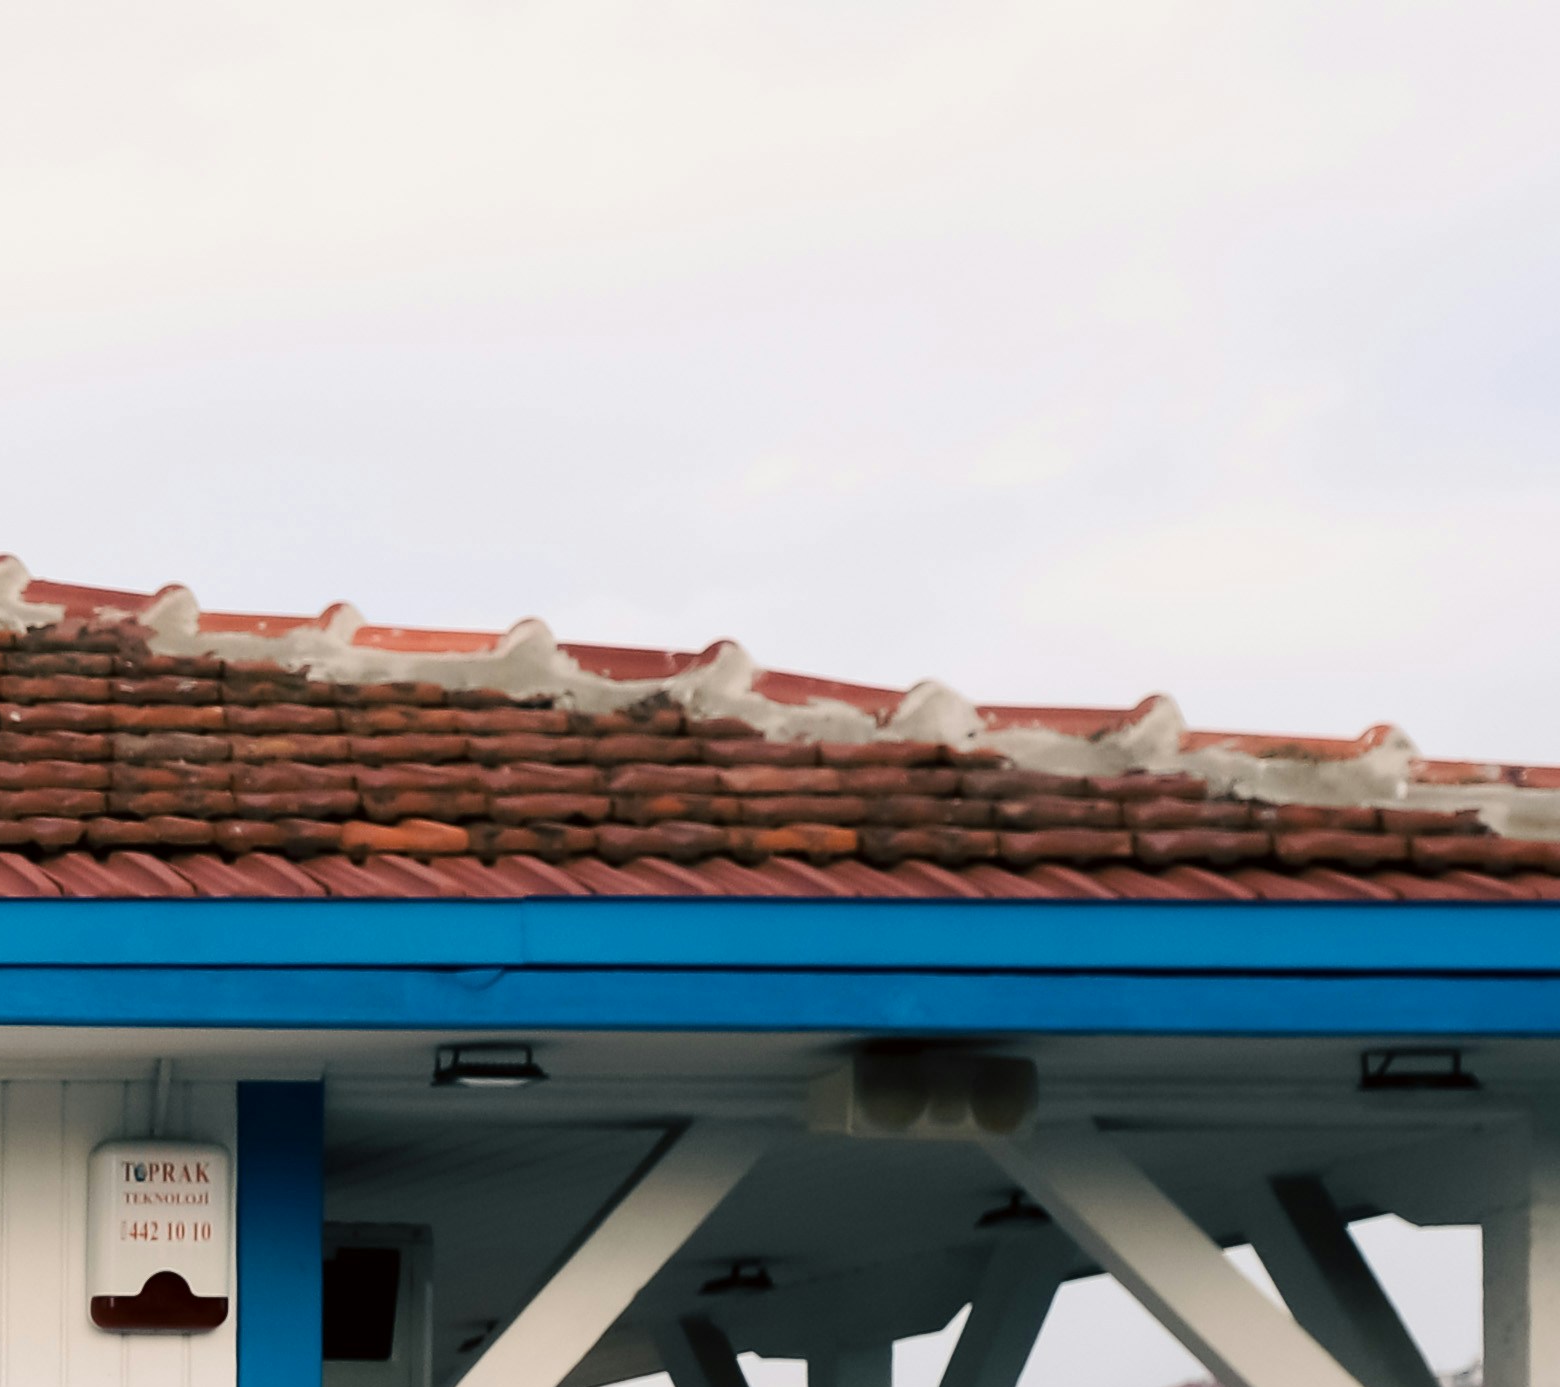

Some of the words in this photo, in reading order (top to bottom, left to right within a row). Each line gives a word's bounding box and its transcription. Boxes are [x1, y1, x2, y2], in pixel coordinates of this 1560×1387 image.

[122, 1161, 209, 1183] TOPRAK
[129, 1221, 159, 1241] 442
[167, 1222, 186, 1241] 10
[193, 1222, 211, 1242] 10
